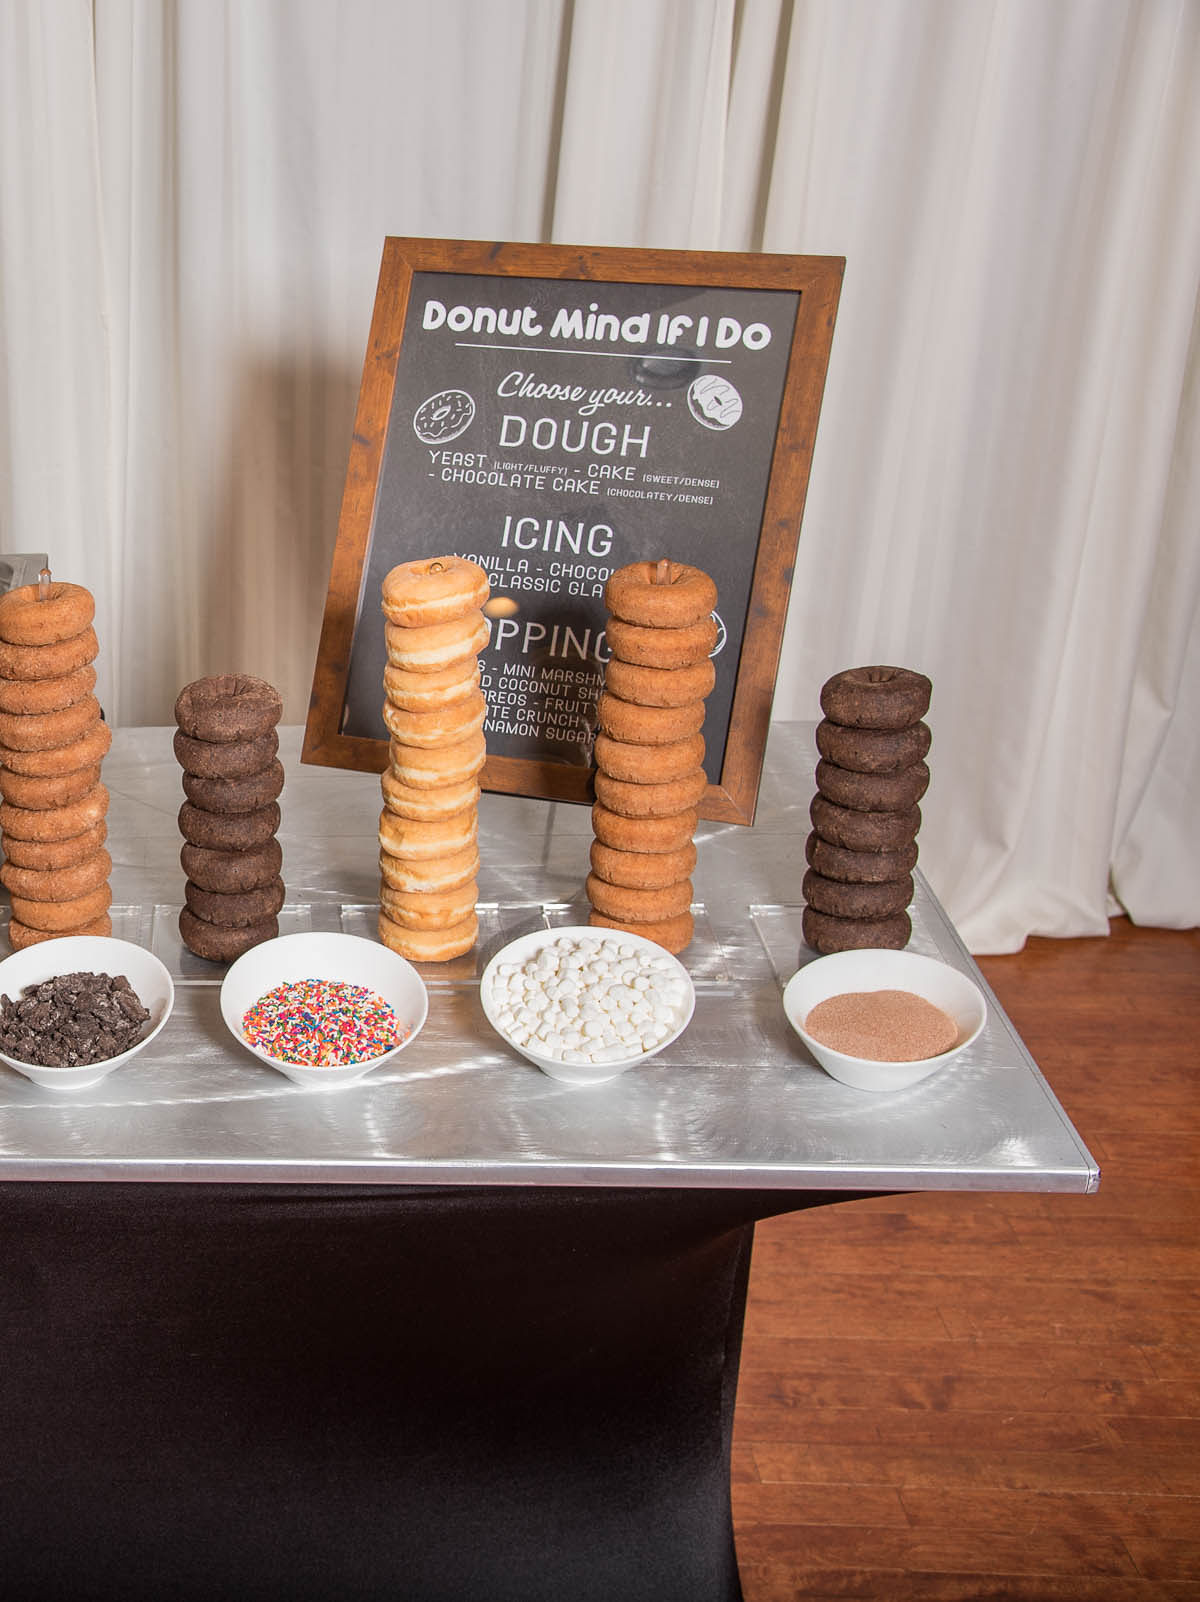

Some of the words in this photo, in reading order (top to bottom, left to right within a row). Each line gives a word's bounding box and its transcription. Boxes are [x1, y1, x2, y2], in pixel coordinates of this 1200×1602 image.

[422, 300, 543, 337] Donut
[549, 302, 650, 343] Mind
[656, 314, 693, 345] If
[696, 316, 709, 347] I
[715, 317, 772, 350] Do
[497, 371, 587, 402] Choose
[499, 415, 651, 458] DOUGH
[429, 450, 488, 468] YEAST
[587, 464, 636, 481] CAKE
[441, 468, 546, 489] CHOCOLATE
[552, 478, 601, 495] CAKE
[501, 516, 614, 557] ICING
[488, 573, 561, 593] CLASSIC
[503, 662, 536, 679] MINI
[498, 676, 571, 697] COCONUT
[516, 708, 579, 728] CRUNCH
[545, 727, 597, 745] SUGAR
